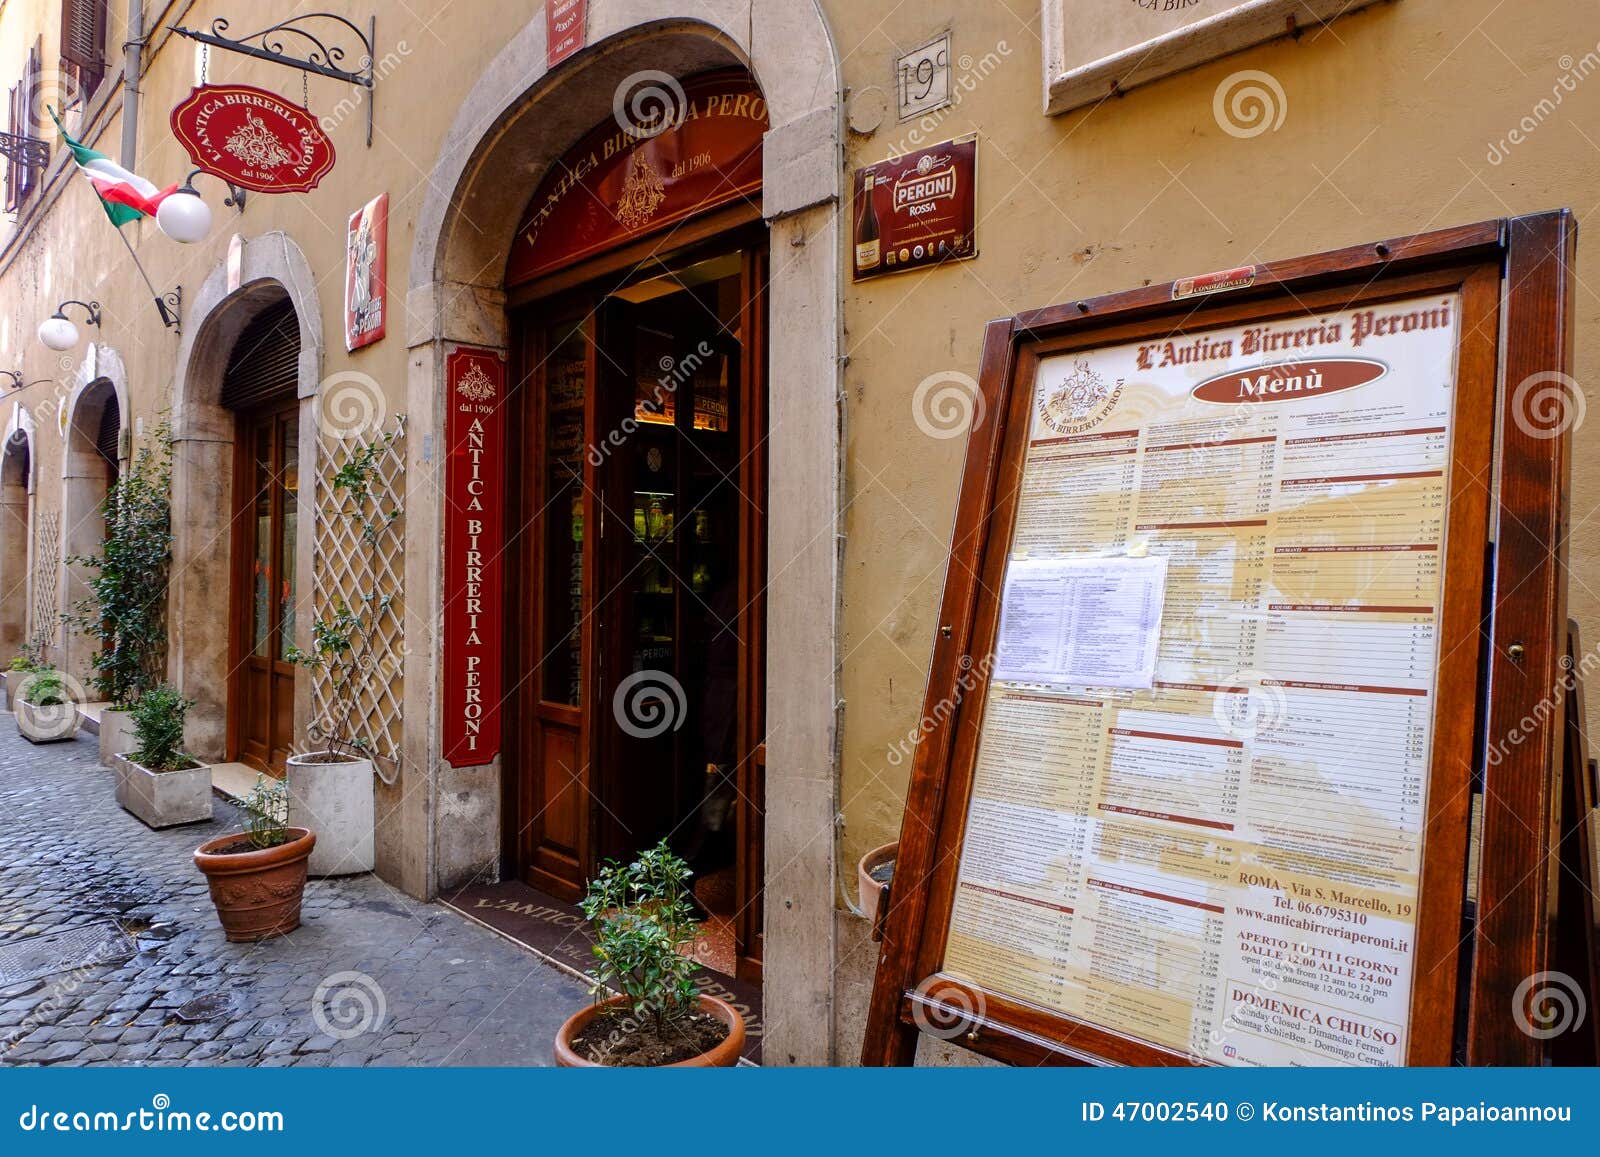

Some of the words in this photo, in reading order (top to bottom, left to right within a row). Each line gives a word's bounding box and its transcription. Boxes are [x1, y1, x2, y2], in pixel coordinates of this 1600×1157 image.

[196, 99, 225, 162] L'ANTICA
[224, 94, 297, 127] BIRRERIA
[292, 127, 315, 178] PERONI
[241, 169, 254, 178] dal
[256, 171, 274, 181] 1906
[525, 151, 600, 246] L'ANTICA
[603, 102, 699, 161] BIRRERIA
[705, 93, 769, 126] PERO
[672, 161, 686, 178] dal
[689, 150, 711, 171] 1906
[898, 176, 951, 203] PERONI
[909, 202, 936, 216] ROSSA
[1193, 278, 1248, 293] CONDIZIONATA
[1136, 338, 1233, 371] L'Antica
[1241, 318, 1342, 356] Birreria
[1350, 300, 1450, 347] Peroni
[1056, 415, 1103, 434] BIRRERIA
[1101, 378, 1125, 417] PERONI
[1237, 368, 1324, 398] Menù
[460, 403, 472, 413] dal
[475, 404, 494, 414] 1906
[467, 418, 484, 511] ANTICA
[465, 519, 484, 645] BIRRERIA
[464, 656, 482, 750] PERONI
[1239, 872, 1280, 891] ROMA
[1291, 882, 1311, 898] Via
[1315, 888, 1326, 900] S.
[1330, 890, 1391, 915] Marcello,
[1396, 903, 1412, 916] 19
[1273, 896, 1294, 910] Tel.
[1297, 901, 1367, 926] 06.6795310
[1235, 905, 1409, 953] www.anticabirreriaperoni.it
[1237, 930, 1288, 950] APERTO
[1292, 942, 1333, 962] TUTTI
[1335, 952, 1342, 963] I
[1344, 954, 1400, 977] GIORNI
[1240, 942, 1283, 962] DALLE
[1287, 953, 1316, 969] 12.00
[1318, 962, 1355, 978] ALLE
[1360, 971, 1392, 988] 24.00
[1241, 955, 1261, 967] open
[1296, 966, 1317, 981] from
[1319, 973, 1330, 984] 12
[1332, 978, 1346, 988] am
[1348, 980, 1358, 990] to
[1360, 983, 1371, 993] 12
[1372, 988, 1389, 999] pm
[1232, 989, 1322, 1025] DOMENICA
[1327, 1015, 1398, 1046] CHIUSO
[1240, 1007, 1270, 1023] Sunday
[1272, 1012, 1301, 1030] Closed
[1309, 1025, 1353, 1045] Dimanche
[1356, 1036, 1384, 1055] Fermé
[1314, 1039, 1356, 1060] Domingo
[1357, 1048, 1394, 1067] Cerrado
